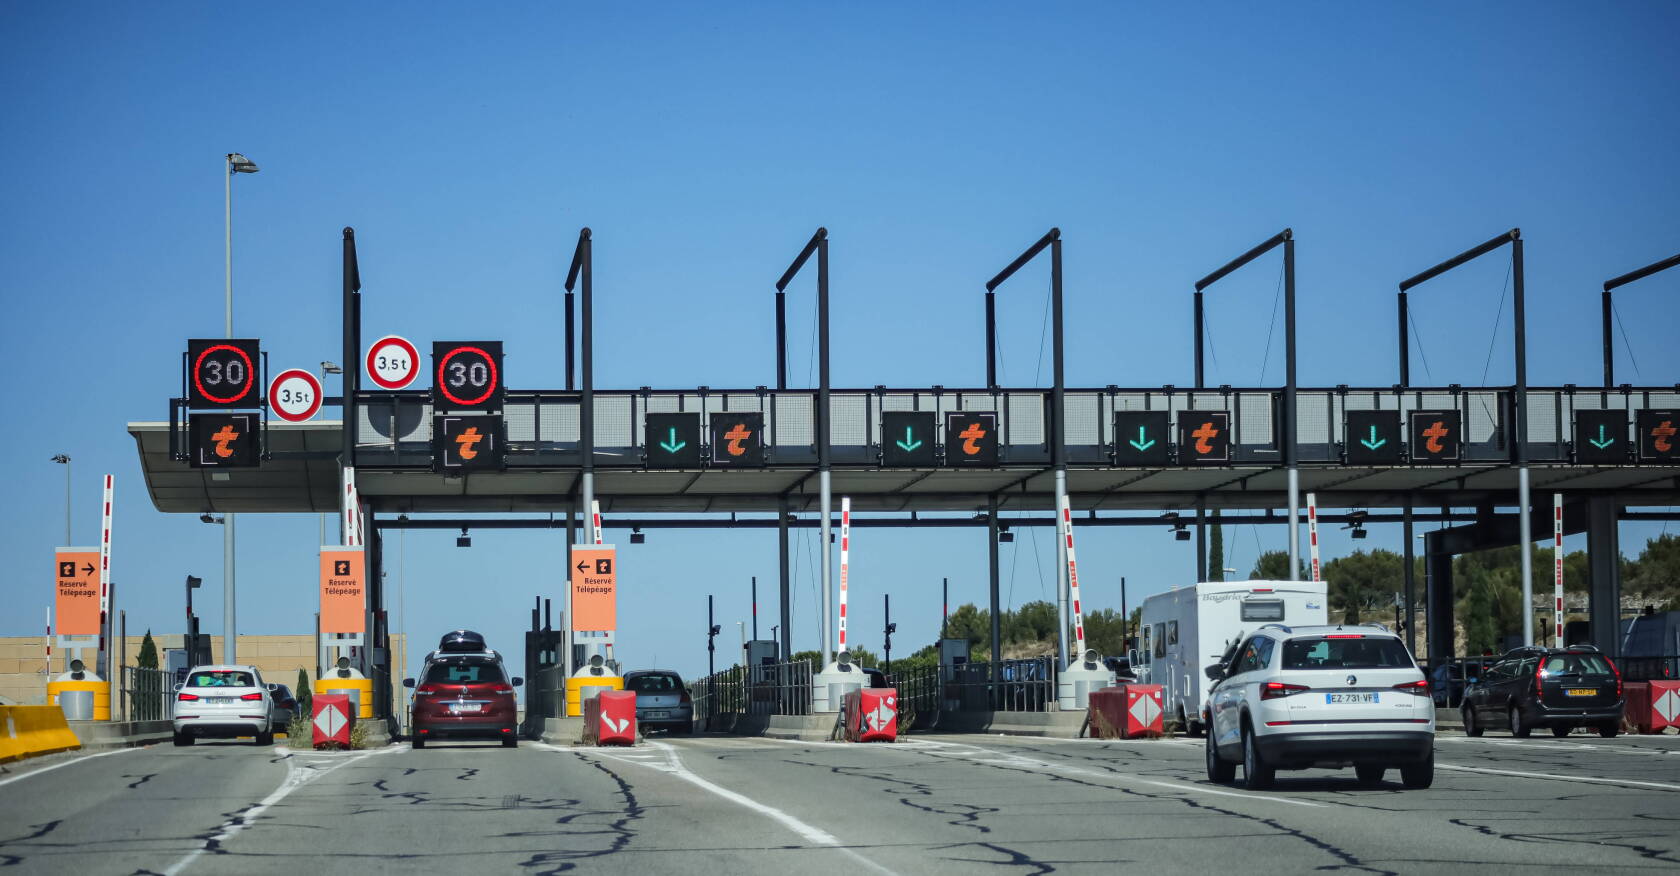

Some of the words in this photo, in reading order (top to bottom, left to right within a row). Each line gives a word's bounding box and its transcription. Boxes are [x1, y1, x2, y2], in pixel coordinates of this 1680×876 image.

[205, 360, 244, 385] 30
[449, 362, 488, 387] 30
[328, 578, 357, 587] Réservé
[584, 577, 612, 585] Réservé
[325, 587, 361, 596] Télépéage
[576, 585, 612, 595] Télépéage
